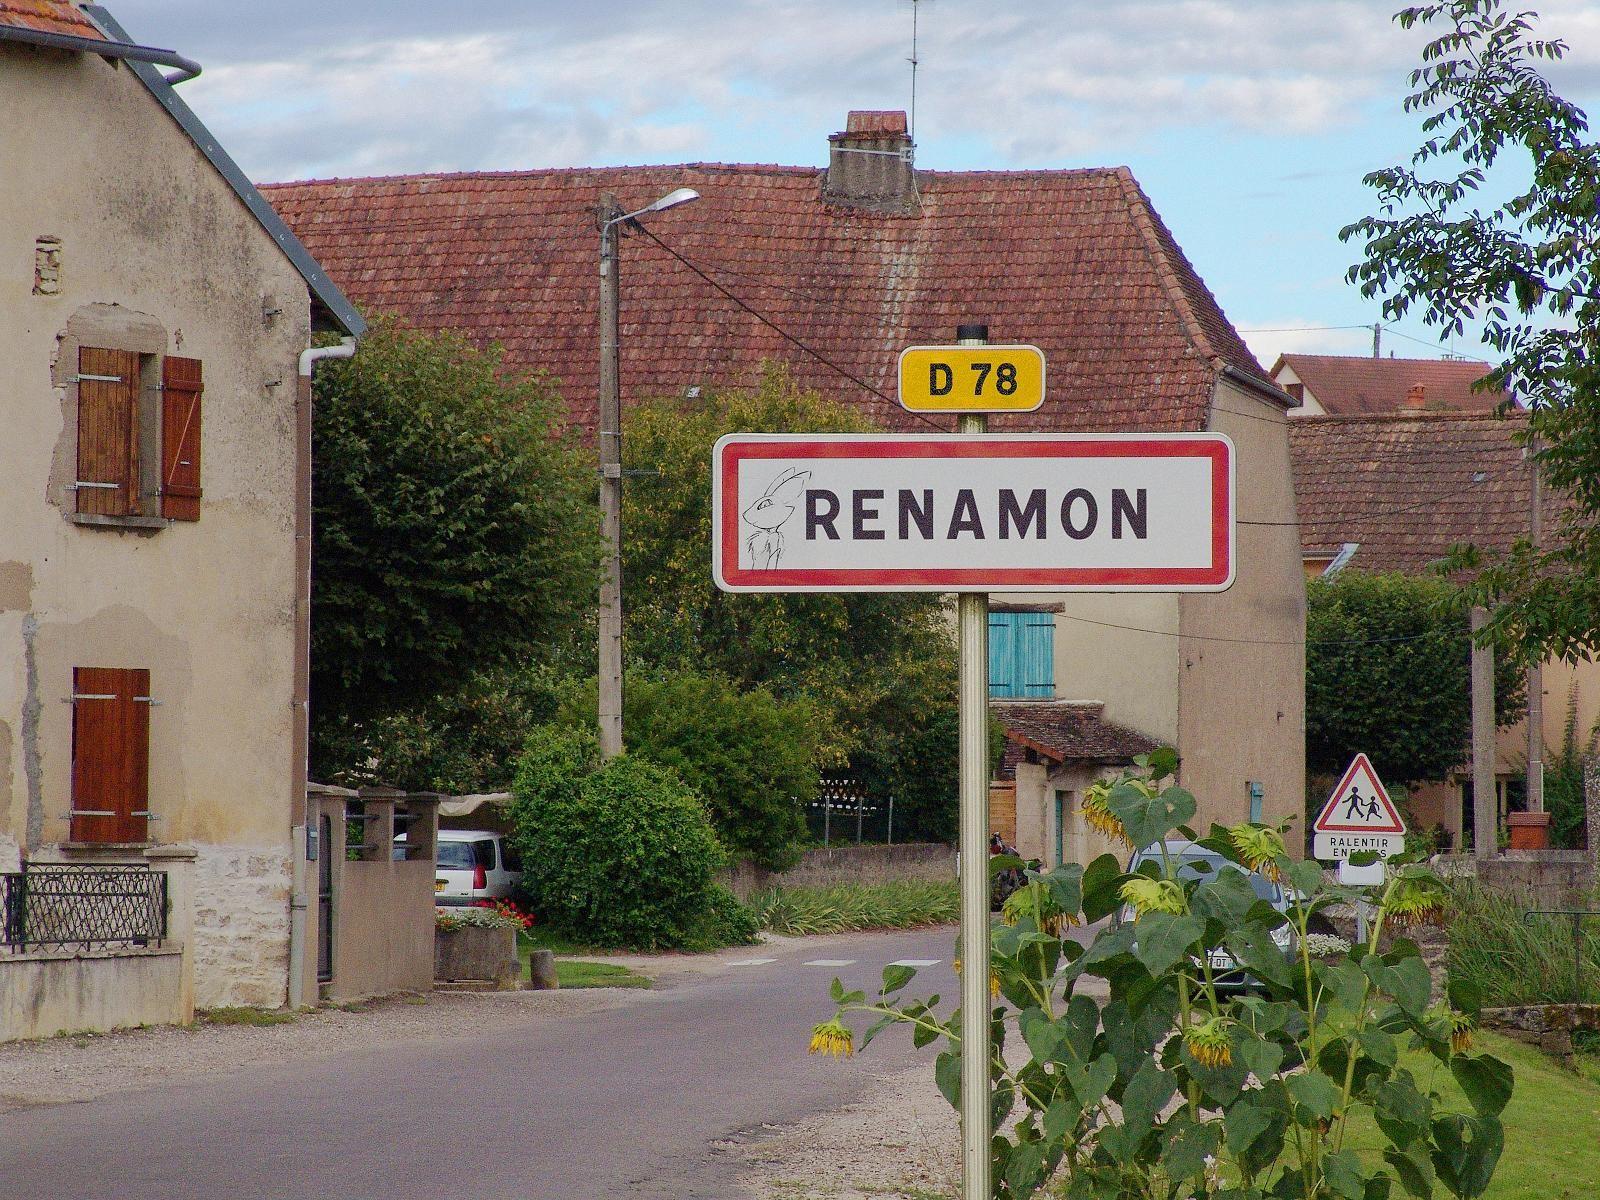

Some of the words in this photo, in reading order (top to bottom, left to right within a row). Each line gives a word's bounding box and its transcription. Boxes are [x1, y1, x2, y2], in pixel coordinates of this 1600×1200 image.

[930, 363, 953, 395] D
[971, 363, 1018, 395] 78
[805, 488, 1147, 540] RENAMON
[1330, 837, 1388, 848] RALENTIR
